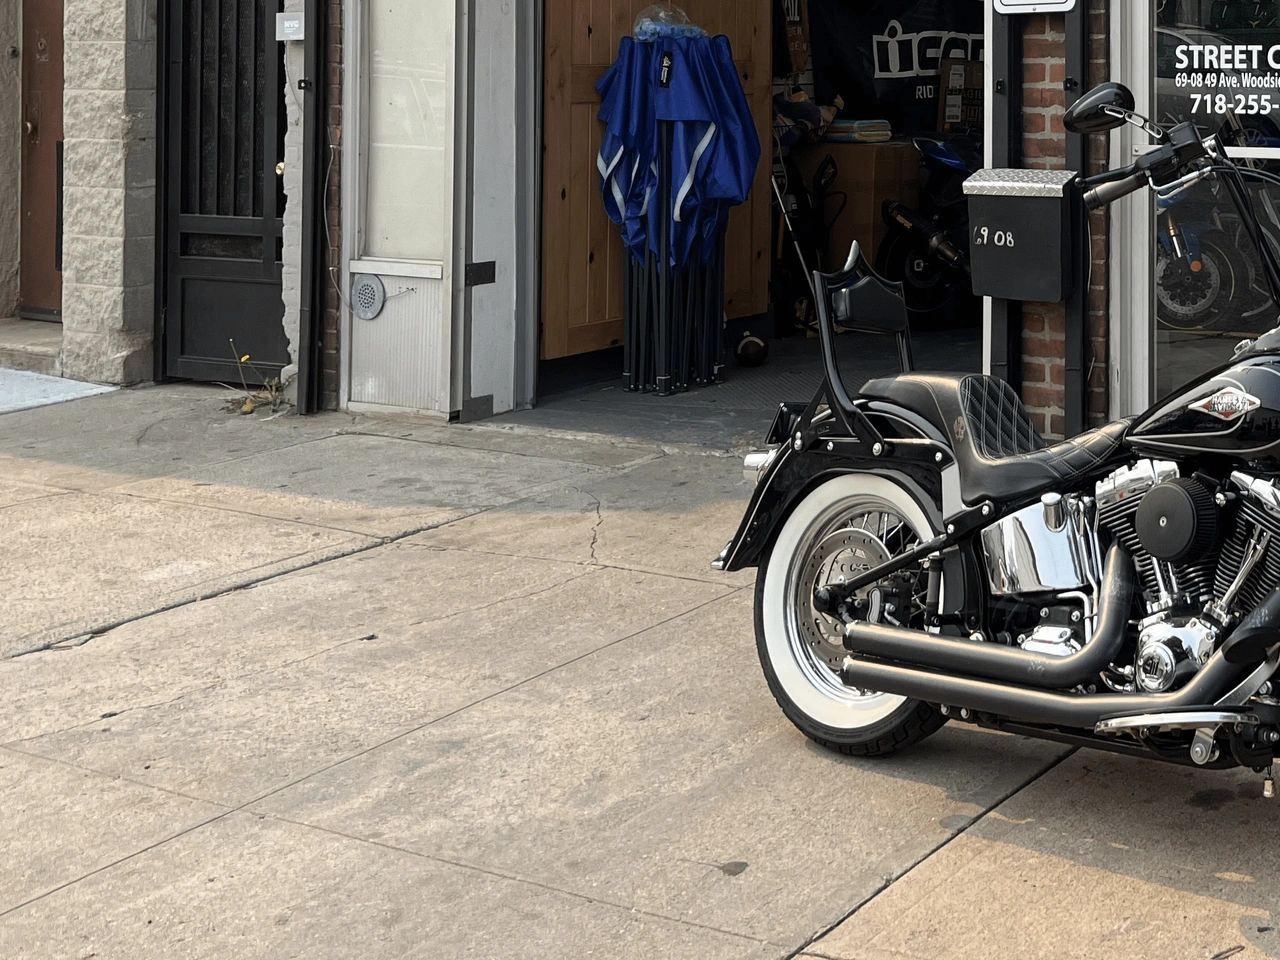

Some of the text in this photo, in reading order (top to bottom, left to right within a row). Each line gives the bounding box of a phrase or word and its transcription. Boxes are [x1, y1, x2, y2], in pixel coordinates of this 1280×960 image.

[1175, 44, 1263, 70] STREET
[1175, 72, 1203, 88] 69-08
[1204, 72, 1217, 88] 49
[1218, 73, 1240, 88] Ave.
